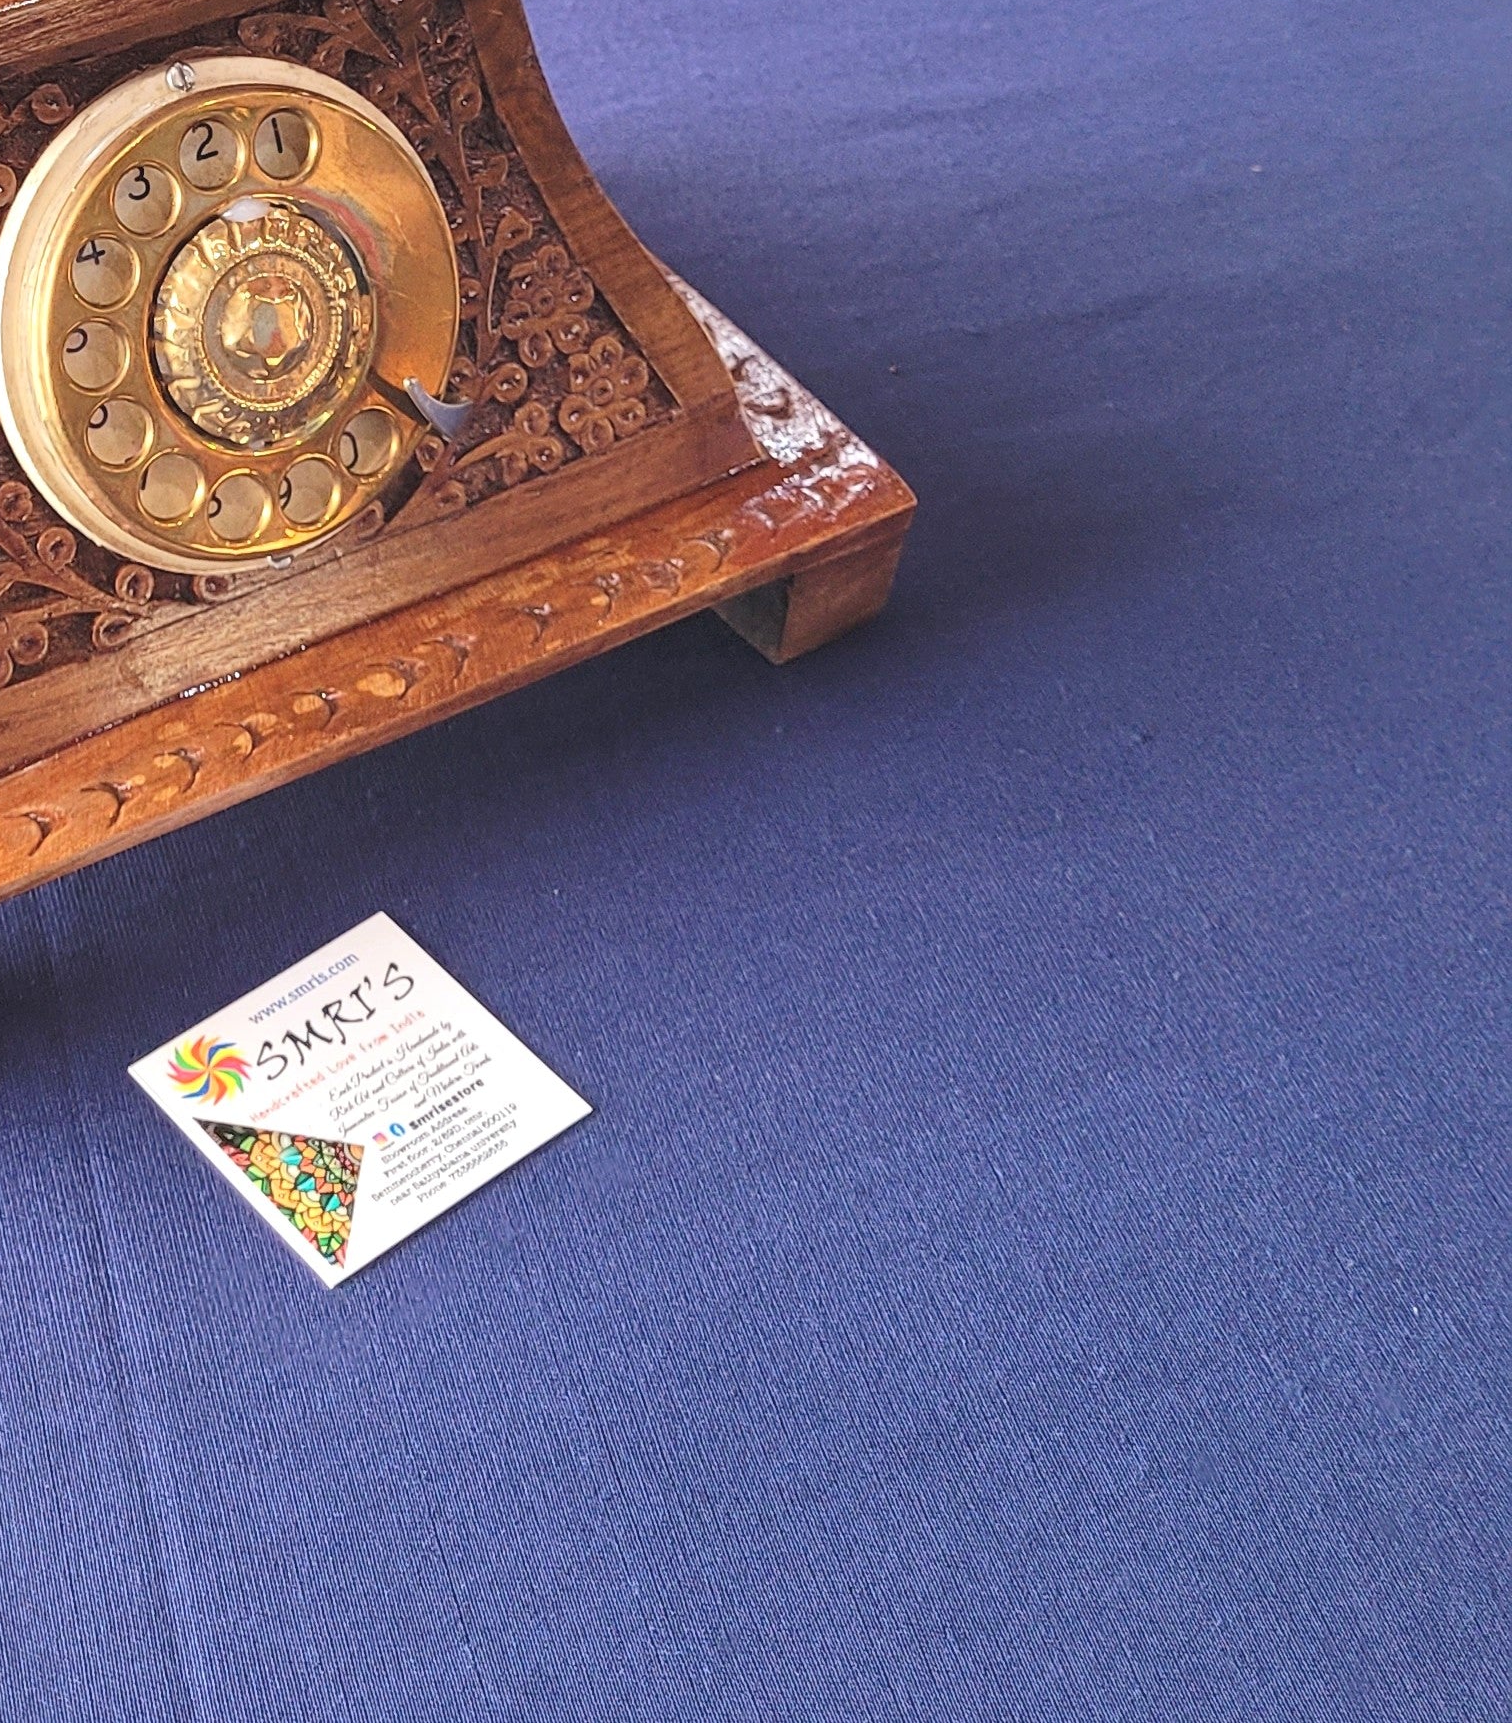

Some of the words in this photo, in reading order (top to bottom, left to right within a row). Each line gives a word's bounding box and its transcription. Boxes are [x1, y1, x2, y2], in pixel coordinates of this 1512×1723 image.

[191, 123, 219, 161] 2
[271, 117, 283, 154] 1
[75, 240, 106, 265] 4
[248, 953, 360, 1024] www.smris.com
[256, 962, 414, 1081] SMRI'S
[249, 1071, 326, 1123] Handcrafted
[326, 1053, 357, 1074] Love
[358, 1033, 389, 1053] from
[388, 1010, 426, 1034] India
